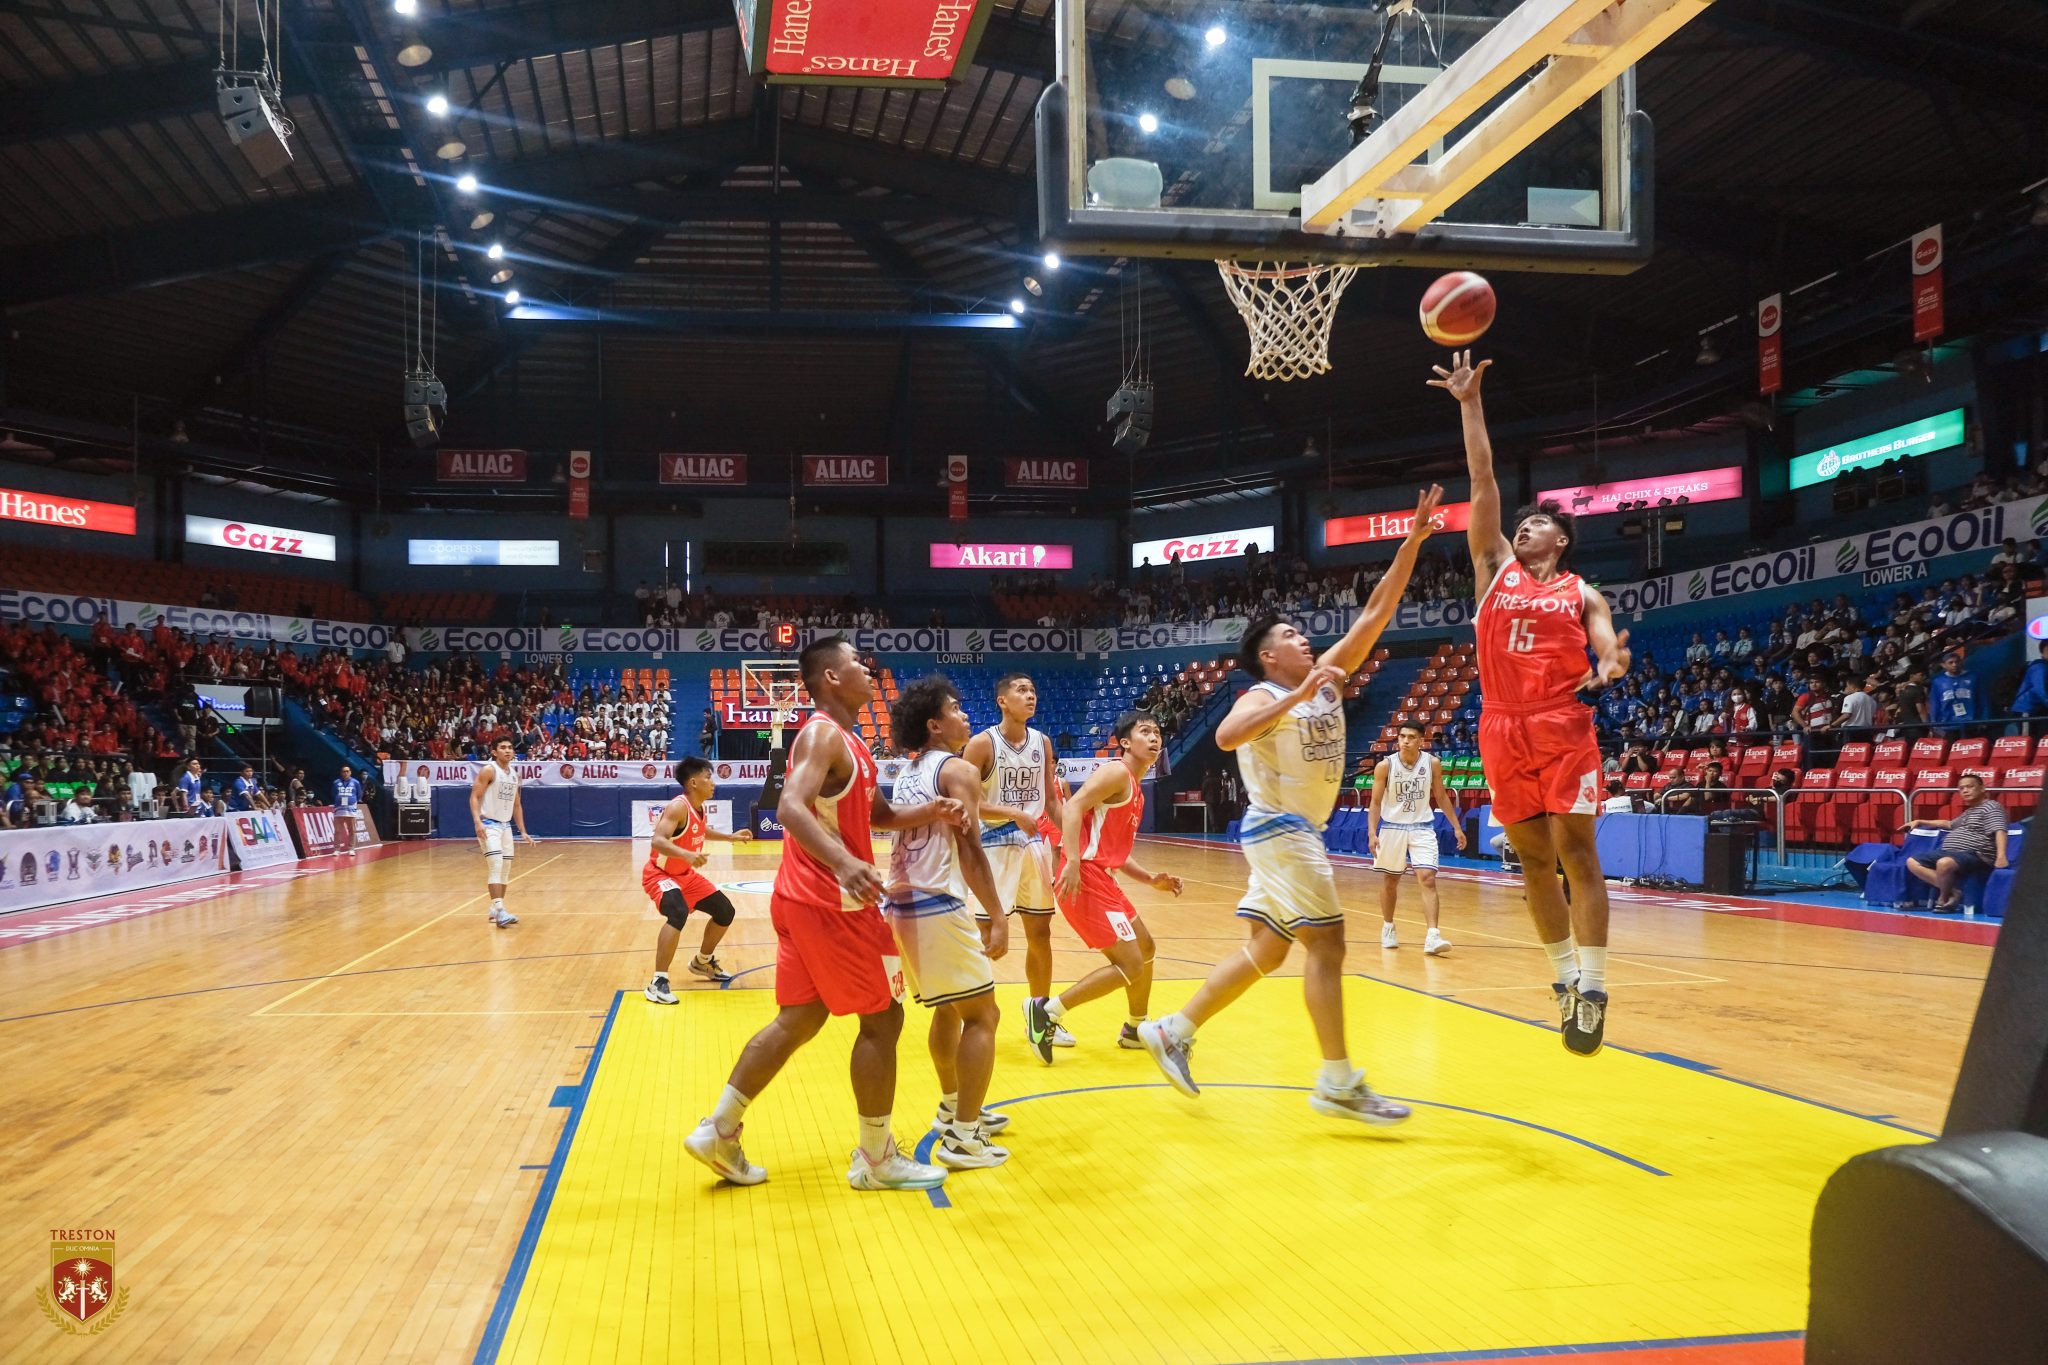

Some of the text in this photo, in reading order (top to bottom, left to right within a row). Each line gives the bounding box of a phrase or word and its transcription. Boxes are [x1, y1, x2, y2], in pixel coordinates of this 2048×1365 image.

[772, 0, 812, 56] Hane
[451, 453, 513, 474] ALIAC
[673, 458, 734, 477] ALIAC
[815, 459, 875, 478] ALIAC
[1017, 461, 1076, 480] ALIAC
[1624, 489, 1652, 500] CHIX
[1663, 482, 1709, 495] STEAKS
[1368, 513, 1445, 539] Hans
[1865, 506, 2005, 569] EcoOil
[222, 523, 304, 554] Gazz
[958, 546, 1027, 567] Akari
[1163, 539, 1238, 562] Gazz
[1711, 547, 1815, 597] EcoOil
[1862, 561, 1928, 588] LOWER A
[1492, 591, 1578, 618] TRESTON
[311, 620, 394, 650] EcoOi
[444, 628, 542, 652] EcoOil
[583, 628, 680, 651] EcoOil
[778, 626, 793, 643] 12
[855, 629, 950, 652] EcoOil
[989, 629, 1082, 652] EcoOil
[1507, 618, 1537, 653] 15
[524, 652, 563, 665] LOWER
[936, 653, 984, 664] LOWER H
[436, 766, 467, 781] ALIAC
[582, 766, 618, 779] ALIAC
[998, 766, 1041, 790] ICCT
[1402, 800, 1416, 813] 24
[1116, 920, 1132, 938] 31
